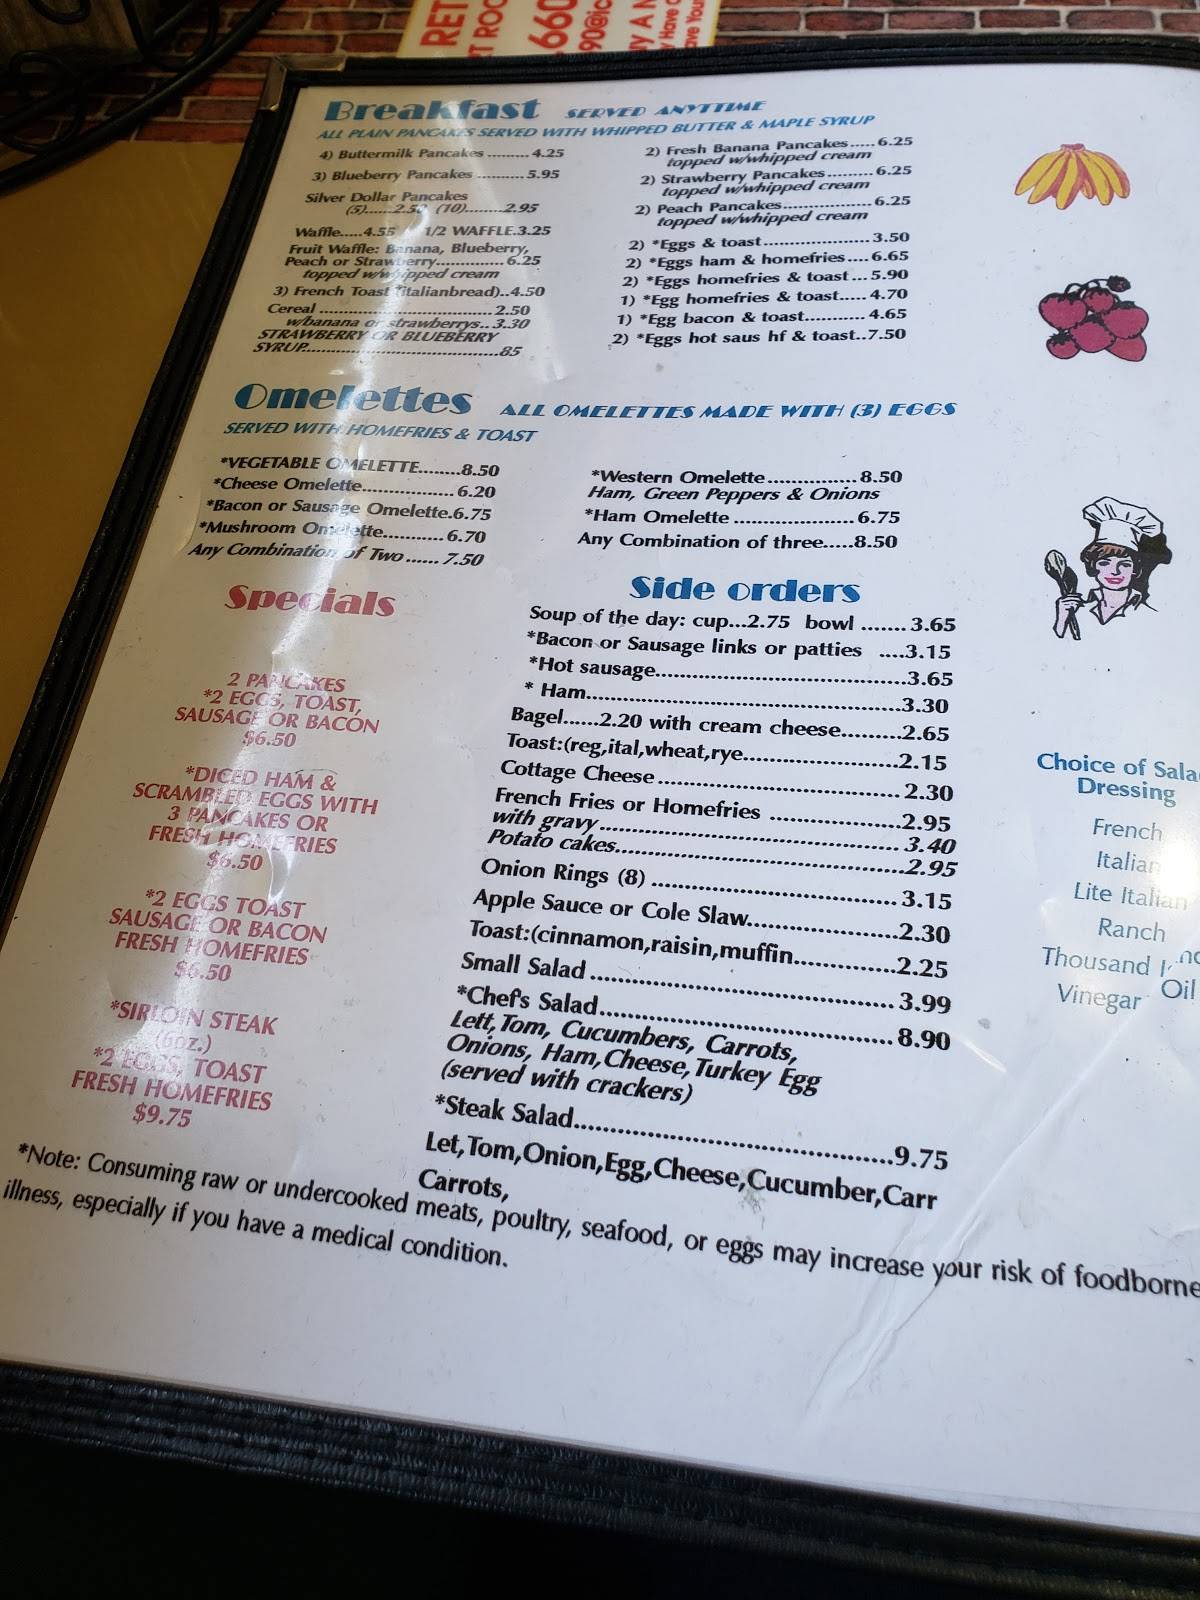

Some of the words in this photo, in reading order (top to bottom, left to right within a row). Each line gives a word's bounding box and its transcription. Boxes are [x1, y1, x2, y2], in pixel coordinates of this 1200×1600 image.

[629, 14, 655, 28] A
[659, 9, 679, 39] Have
[324, 99, 541, 120] Breakfast
[565, 106, 646, 120] SERVED
[655, 101, 766, 114] ANYTTIME
[348, 129, 393, 138] PLAIN
[396, 128, 474, 137] PANCAKES
[479, 128, 538, 137] SERVED
[543, 126, 588, 138] WITH
[591, 124, 666, 136] WHIPPED
[672, 121, 736, 133] BUTTER
[741, 120, 753, 129] &
[759, 117, 815, 129] MAPLE
[819, 115, 875, 126] SYRUP
[320, 150, 332, 160] 4)
[338, 148, 412, 159] Buttermilk
[419, 149, 484, 158] Pancakes
[532, 149, 564, 157] 4.25
[645, 147, 660, 157] 2)
[666, 144, 706, 156] Fresh
[714, 144, 769, 153] Banana
[666, 155, 723, 168] topped
[729, 151, 816, 167] w/whipped
[822, 150, 871, 160] cream
[312, 172, 325, 181] 3)
[332, 170, 400, 182] Blueberry
[407, 169, 472, 179] Pancakes
[527, 170, 559, 178] 5.95
[306, 193, 345, 203] Silver
[351, 192, 395, 201] Dollar
[401, 191, 468, 201] Pancakes
[622, 276, 638, 287] 2)
[697, 272, 780, 285] homefries
[787, 272, 801, 282] &
[807, 271, 848, 282] toast
[612, 334, 628, 345] 2)
[689, 331, 717, 344] hot
[723, 332, 760, 342] saus
[768, 330, 785, 342] hf
[792, 331, 806, 341] &
[235, 383, 472, 415] Omelettes
[500, 404, 546, 417] ALL
[554, 404, 696, 419] OMELETTES
[699, 405, 773, 419] MADE
[780, 404, 844, 417] WITH
[850, 403, 882, 419] (3)
[888, 402, 957, 416] EGGS
[224, 423, 288, 434] SERVED
[293, 423, 342, 435] WITH
[348, 425, 453, 439] HOMEFRIES
[455, 429, 469, 439] &
[477, 429, 538, 442] TOAST
[587, 486, 635, 500] Ham,
[644, 487, 699, 500] Green
[705, 488, 780, 504] Peppers
[786, 489, 803, 500] &
[810, 487, 880, 500] Onions
[577, 533, 612, 549] Any
[620, 532, 739, 549] Combination
[747, 534, 768, 549] of
[225, 584, 396, 618] Specials
[630, 576, 715, 600] Side
[728, 579, 861, 603] orders
[529, 605, 576, 624] Soup
[583, 608, 603, 624] of
[608, 609, 639, 626] the
[646, 611, 685, 630] day:
[806, 615, 854, 631] bowl
[600, 638, 621, 650] or
[628, 636, 704, 655] Sausage
[712, 638, 757, 655] links
[764, 642, 787, 656] or
[794, 642, 862, 660] patties
[269, 712, 298, 727] OR
[306, 717, 379, 733] BACON
[1037, 752, 1115, 774] Choice
[1123, 759, 1147, 775] of
[264, 771, 313, 789] HAM
[320, 775, 336, 790] &
[500, 760, 576, 781] Cottage
[583, 766, 655, 785] Cheese
[905, 784, 954, 801] 2.30
[1077, 777, 1176, 807] Dressing
[495, 787, 562, 807] French
[569, 793, 615, 810] Fries
[622, 800, 645, 813] or
[653, 798, 761, 820] Homefries
[1092, 818, 1163, 841] French
[481, 858, 545, 879] Onion
[554, 863, 609, 887] Rings
[617, 868, 645, 888] (8)
[901, 891, 952, 910] 3.15
[1074, 882, 1112, 902] Lite
[173, 892, 229, 911] EGGS
[237, 897, 306, 918] TOAST
[472, 889, 535, 912] Apple
[542, 893, 603, 916] Sauce
[611, 902, 633, 918] or
[641, 902, 690, 922] Cole
[1097, 917, 1166, 942] Ranch
[115, 931, 180, 953] FRESH
[1042, 947, 1150, 976] Thousand
[461, 953, 521, 974] Small
[528, 957, 586, 979] Salad
[899, 994, 952, 1015] 3.99
[1161, 979, 1195, 1000] Oil
[1057, 983, 1142, 1015] Vinegar
[210, 1011, 278, 1035] STEAK
[194, 1058, 267, 1083] TOAST
[440, 1059, 523, 1085] (served
[531, 1068, 580, 1091] with
[586, 1075, 693, 1105] crackers)
[71, 1070, 137, 1095] FRESH
[144, 1079, 272, 1110] HOMEFRIES
[133, 1102, 192, 1127] $9.75
[419, 1168, 510, 1202] Carrots,
[3, 1179, 64, 1211] illness,
[72, 1191, 167, 1225] especially
[171, 1200, 189, 1223] if
[193, 1208, 229, 1231] you
[236, 1211, 286, 1239] have
[292, 1223, 305, 1239] a
[312, 1225, 395, 1253] medical
[402, 1235, 508, 1269] condition.
[88, 1153, 196, 1190] Consuming
[201, 1169, 239, 1190] raw
[246, 1176, 268, 1194] or
[273, 1177, 409, 1214] undercooked
[416, 1198, 484, 1227] meats,
[492, 1206, 575, 1240] poultry,
[581, 1217, 674, 1252] seafood,
[684, 1231, 708, 1252] or
[716, 1236, 764, 1265] eggs
[773, 1243, 822, 1272] may
[830, 1247, 925, 1280] increase
[933, 1259, 983, 1288] your
[992, 1260, 1033, 1285] risk
[1041, 1263, 1066, 1287] of
[1074, 1264, 1200, 1299] foodborne
